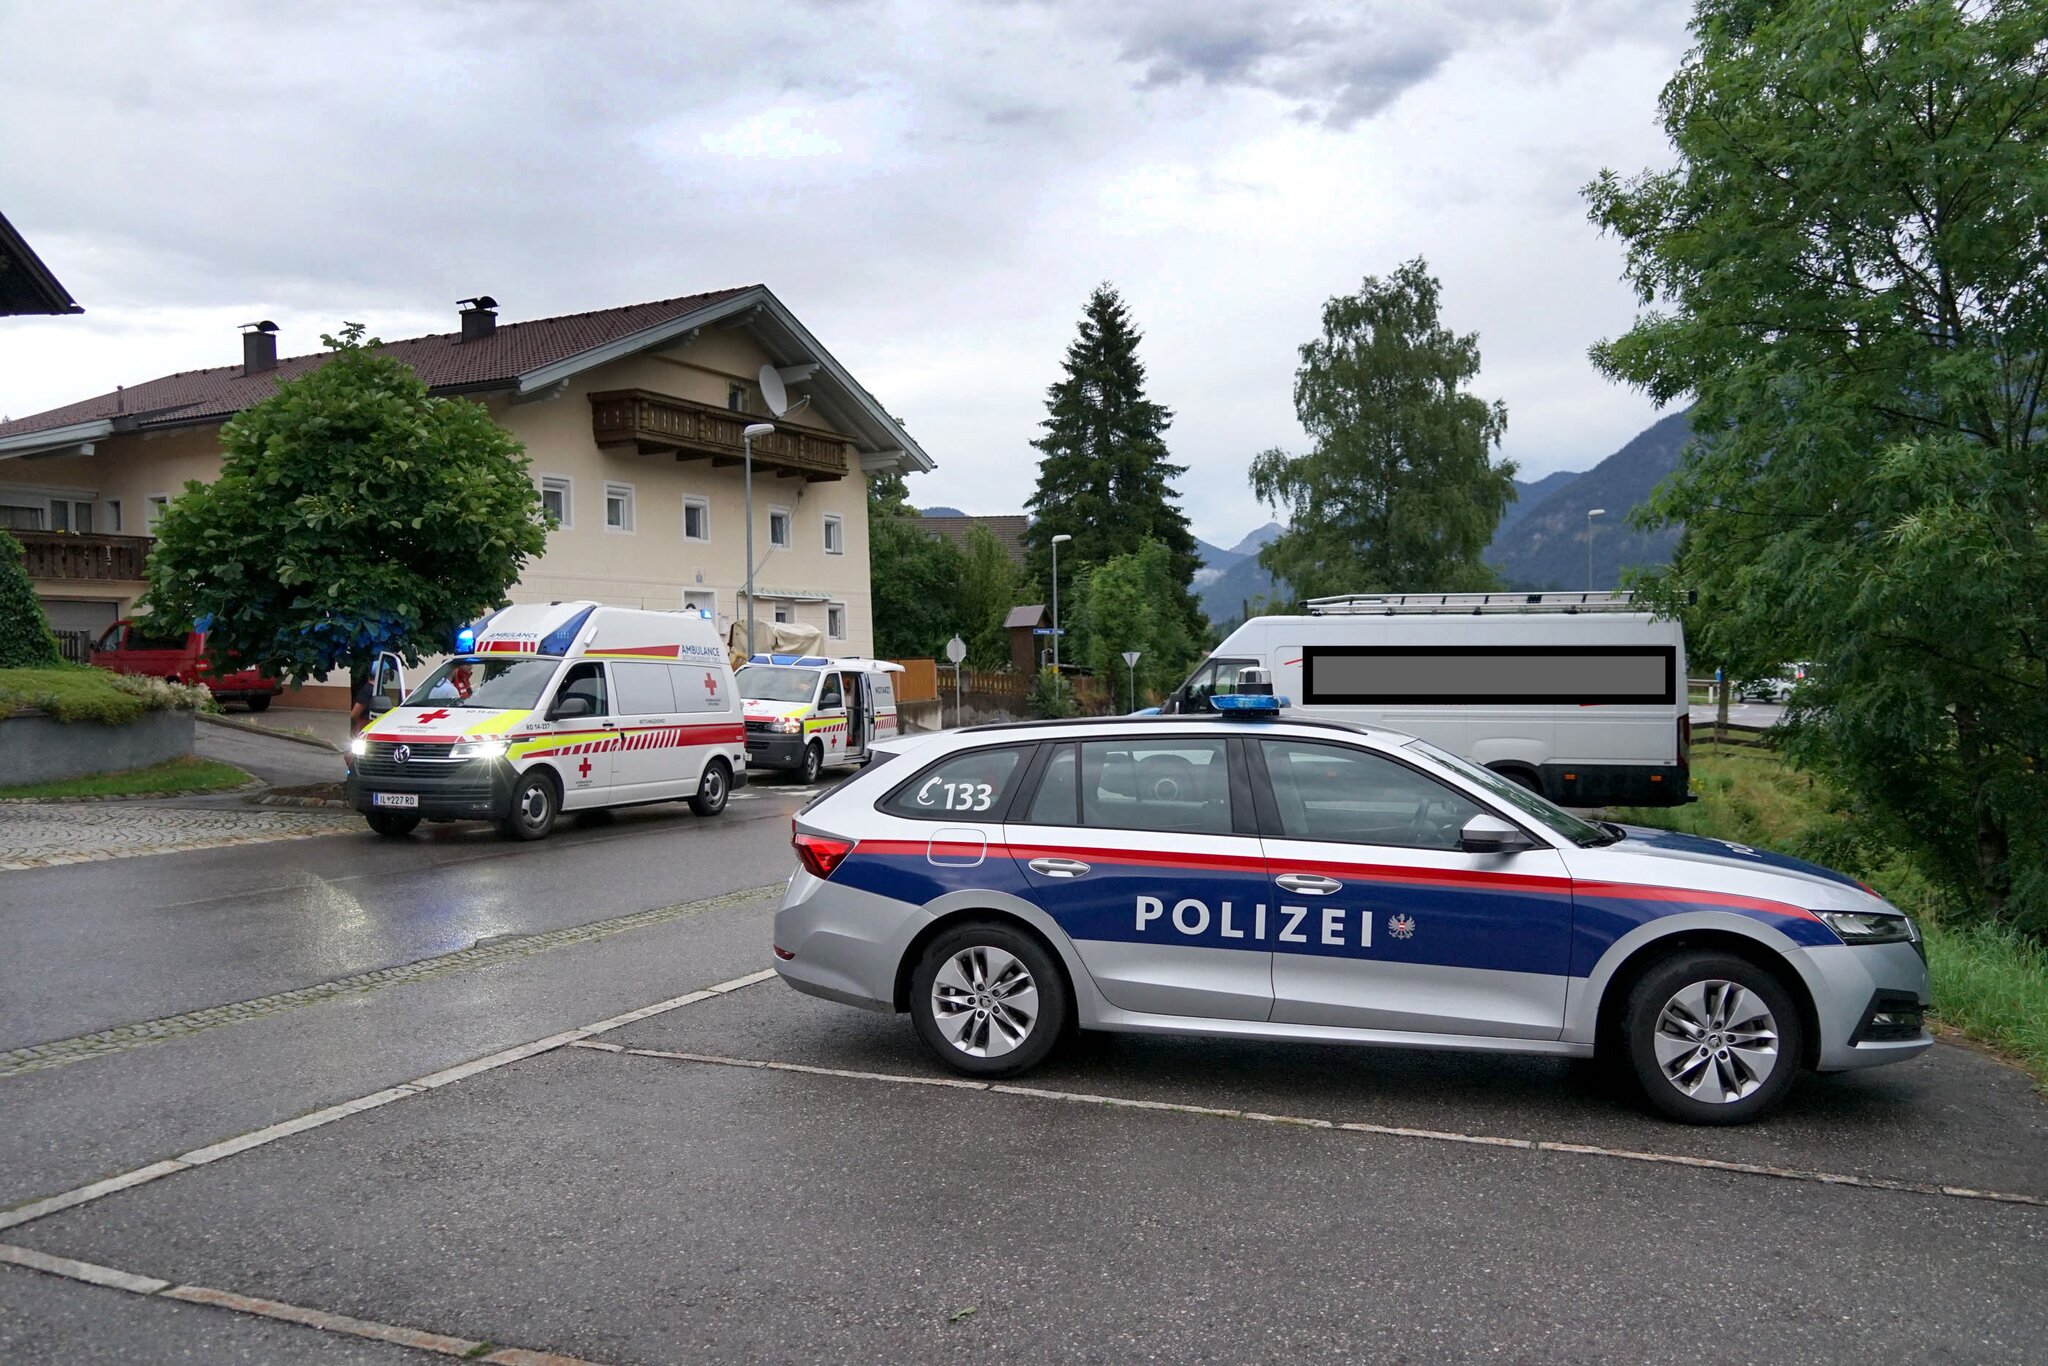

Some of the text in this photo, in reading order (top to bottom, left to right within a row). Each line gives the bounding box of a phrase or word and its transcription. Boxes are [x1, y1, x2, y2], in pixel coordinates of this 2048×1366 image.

[682, 645, 720, 657] AMBULANCE
[391, 795, 404, 805] 227
[405, 796, 415, 806] RD
[944, 783, 993, 812] 133
[1135, 895, 1373, 948] POLIZEI
